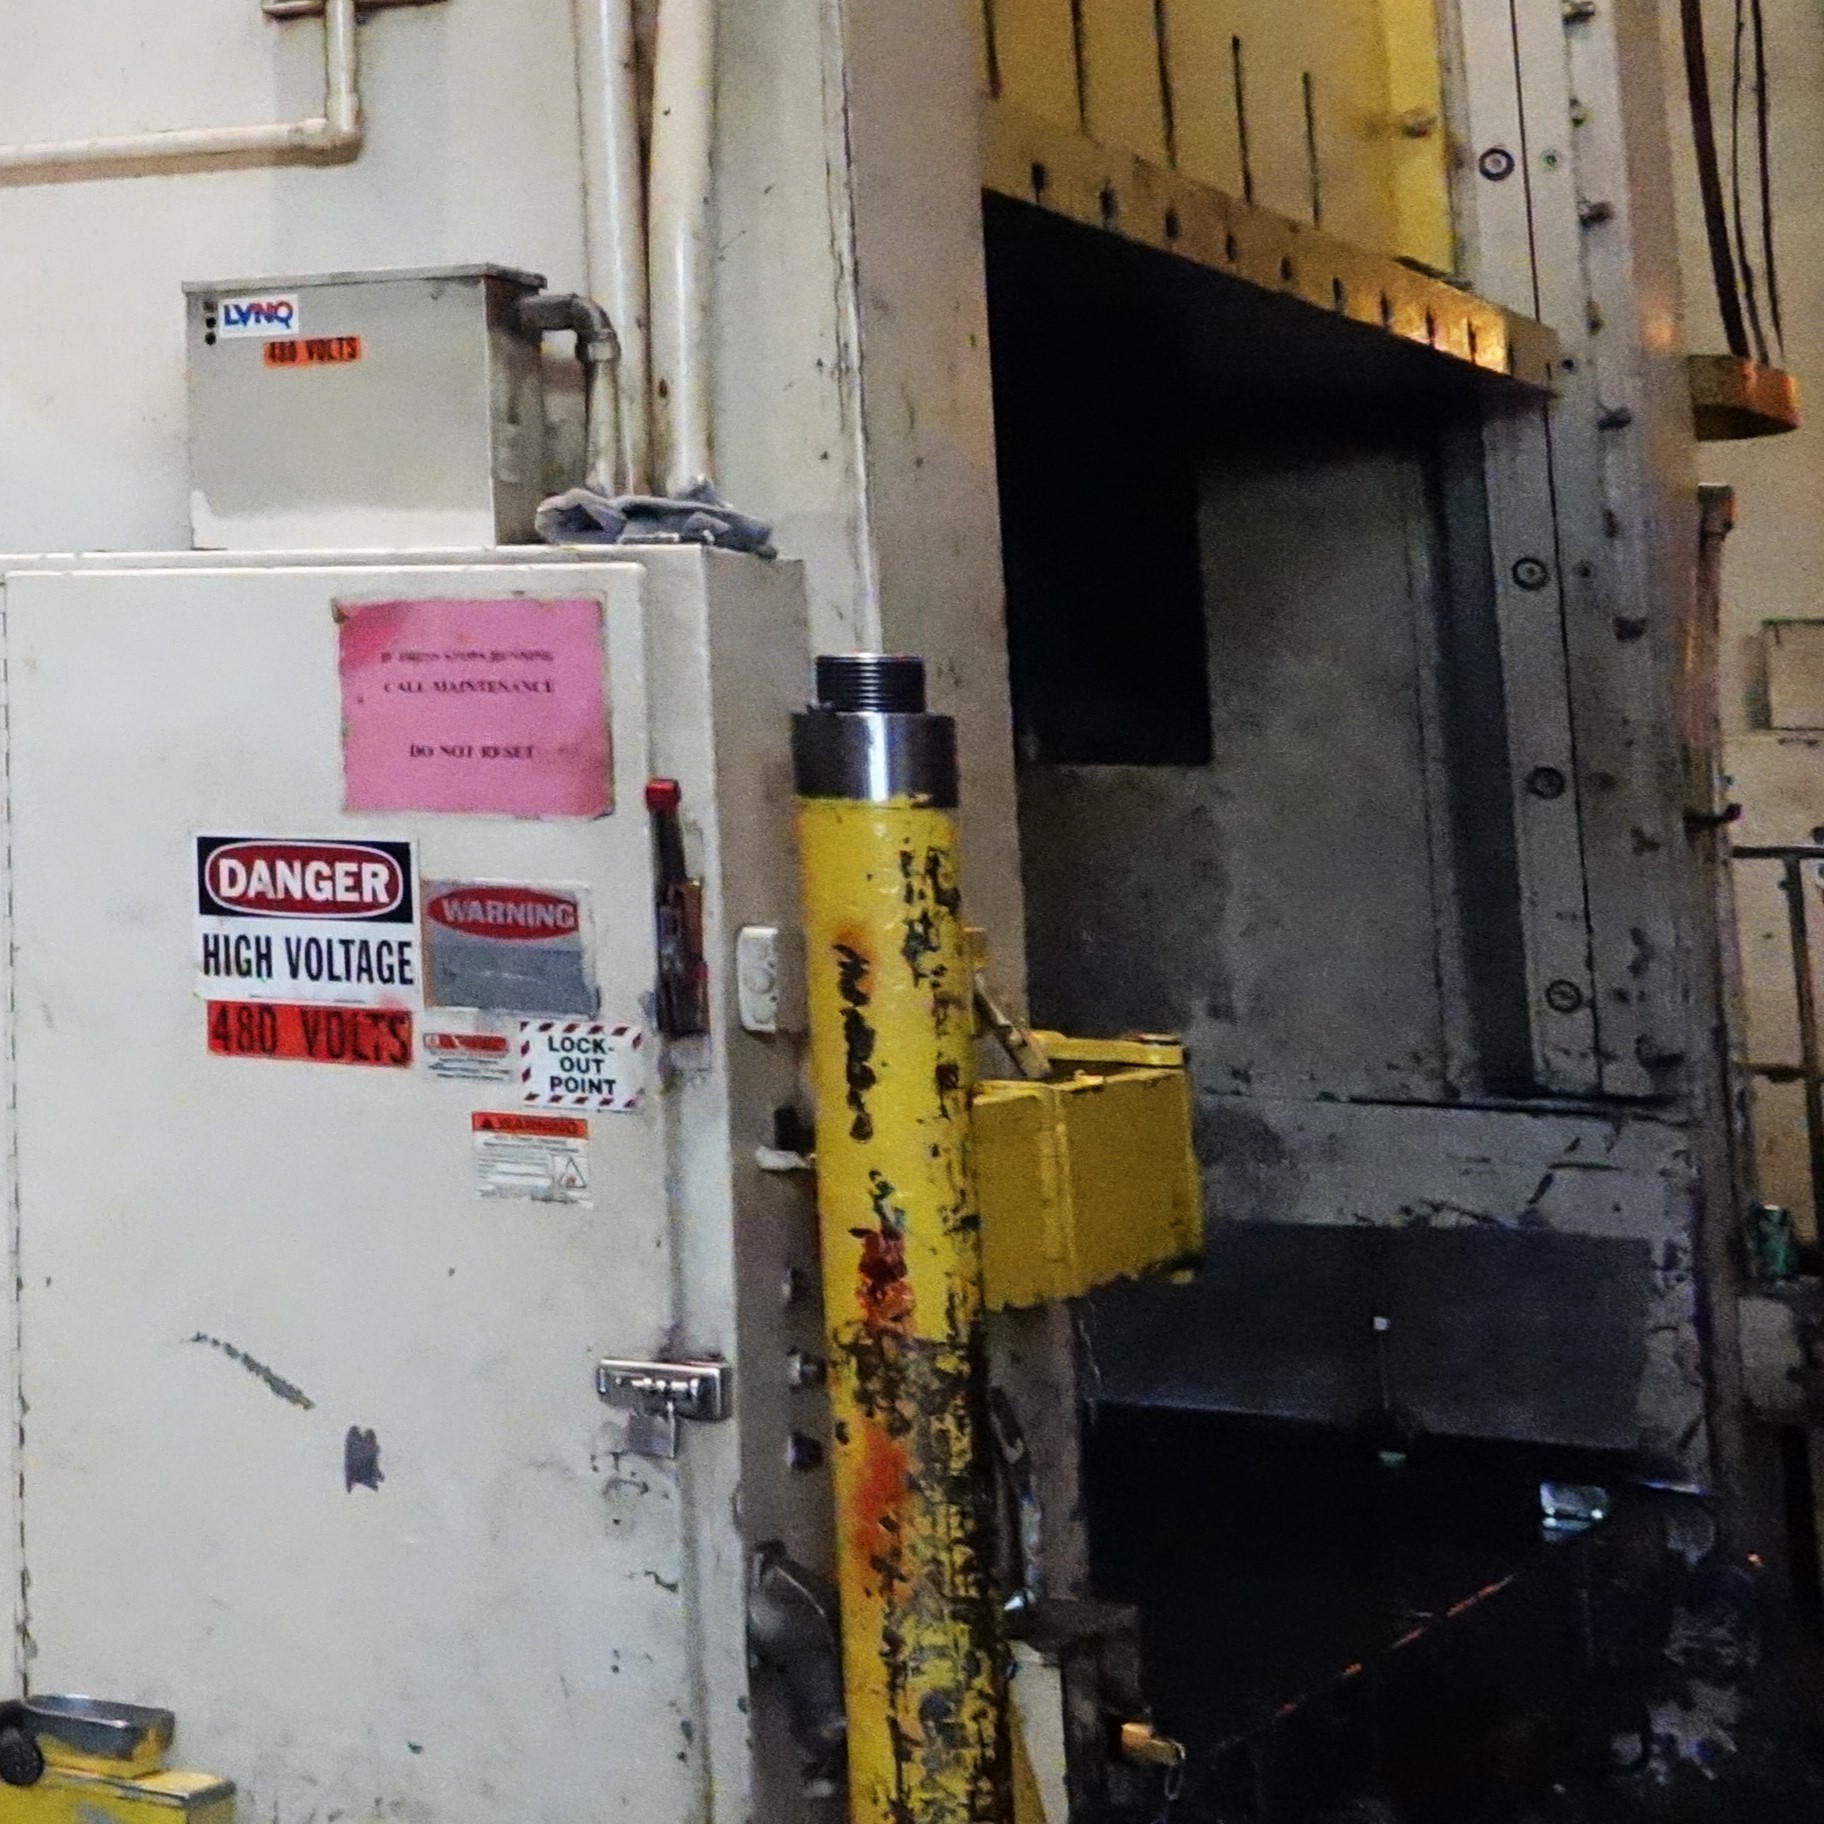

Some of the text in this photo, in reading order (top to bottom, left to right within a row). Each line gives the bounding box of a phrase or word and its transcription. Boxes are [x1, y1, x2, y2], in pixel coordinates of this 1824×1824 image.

[224, 301, 294, 329] LYNQ
[433, 678, 554, 695] MAINTENANCE
[410, 743, 534, 759] DO NOT RESET
[219, 858, 390, 904] DANGER
[441, 897, 576, 929] WARNING
[202, 932, 414, 985] HIGH VOLTAGE
[214, 1004, 278, 1055] 480
[300, 1008, 411, 1067] VOLTS
[548, 1035, 615, 1055] LOCK-
[560, 1056, 605, 1074] OUT
[550, 1076, 616, 1095] POINT
